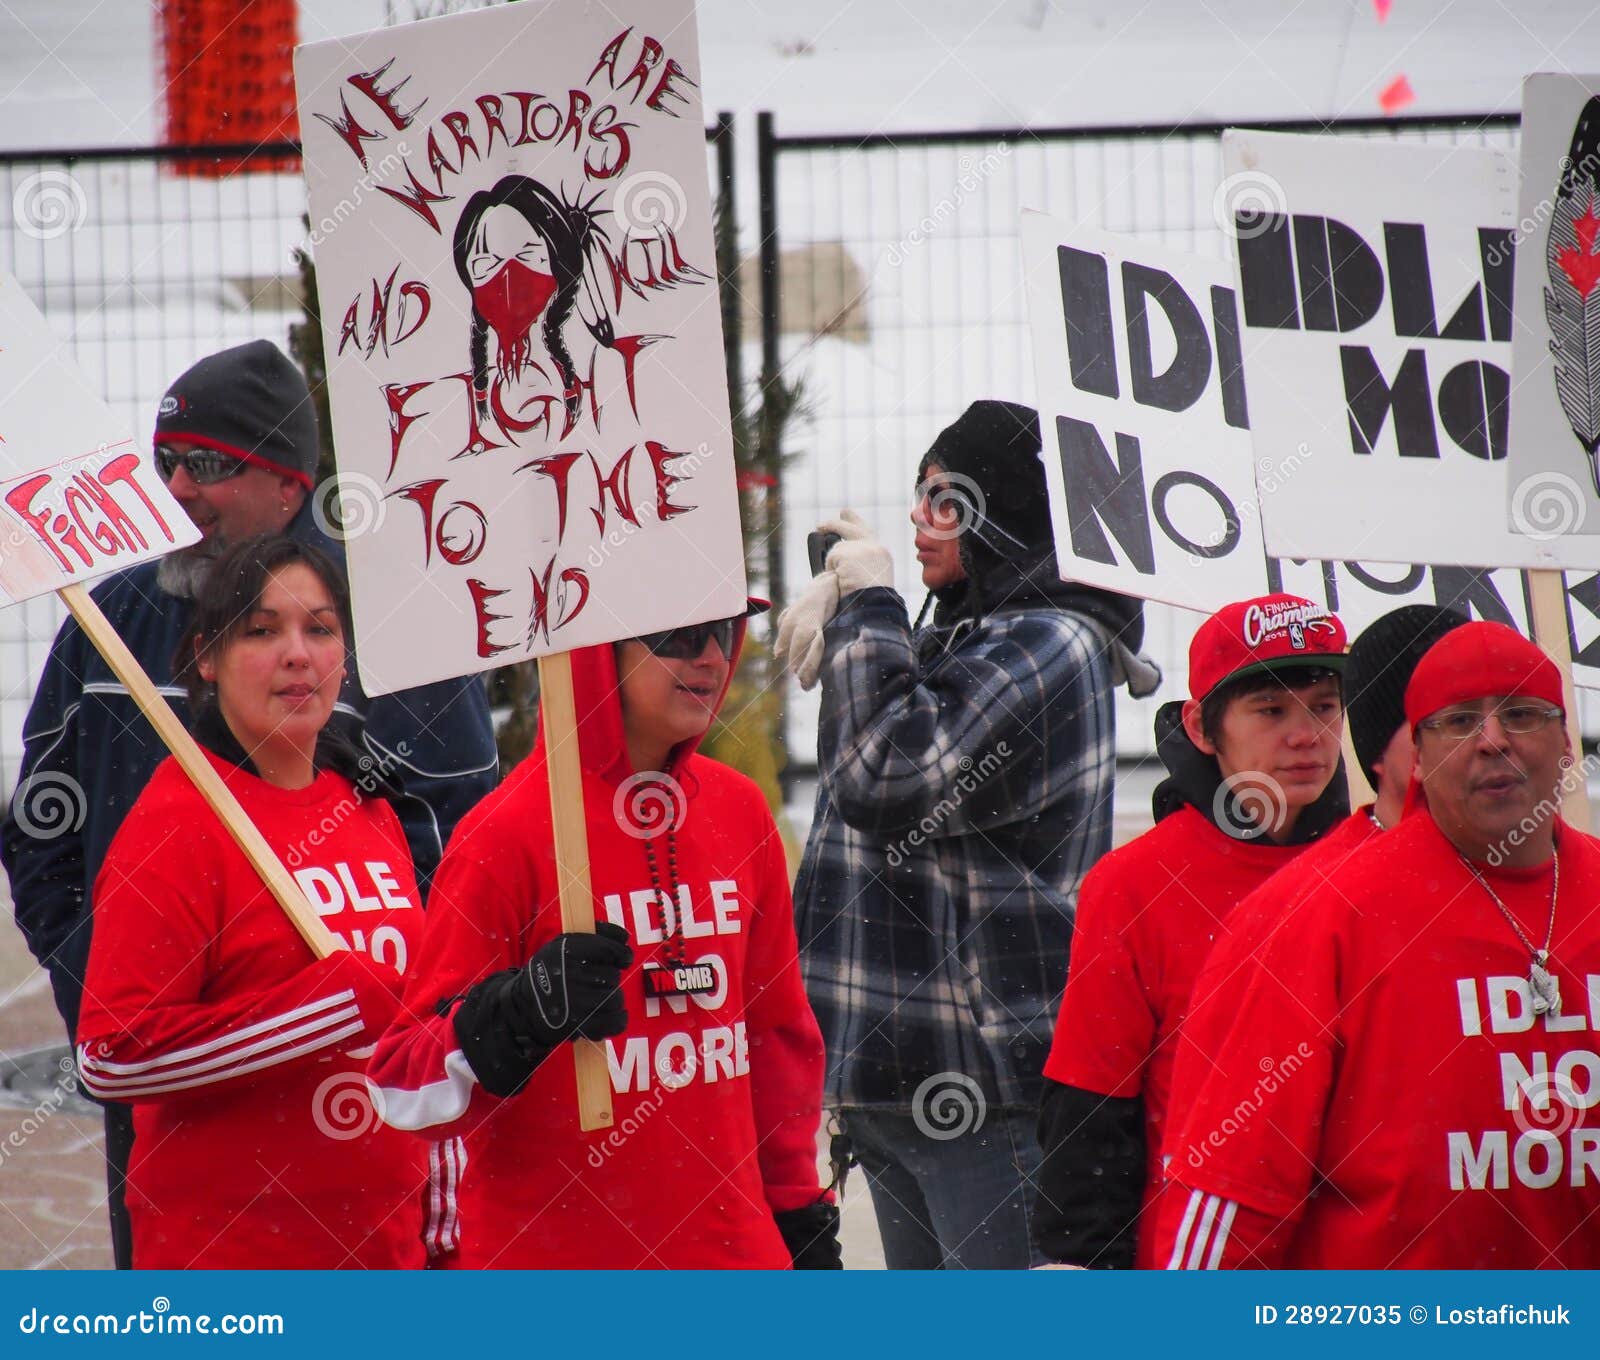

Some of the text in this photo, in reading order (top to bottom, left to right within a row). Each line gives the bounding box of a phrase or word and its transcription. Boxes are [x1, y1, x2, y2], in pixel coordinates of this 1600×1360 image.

[586, 26, 698, 118] ARE
[375, 90, 640, 235] WARRIORS
[338, 262, 431, 361] AND
[379, 334, 676, 482] FIGHT
[512, 440, 698, 546] THE
[1056, 415, 1241, 575] NO
[466, 553, 590, 658] END
[1264, 630, 1288, 642] 2012
[604, 879, 742, 946] IDLE
[1456, 973, 1600, 1037] IDL
[1500, 1050, 1600, 1111] NO
